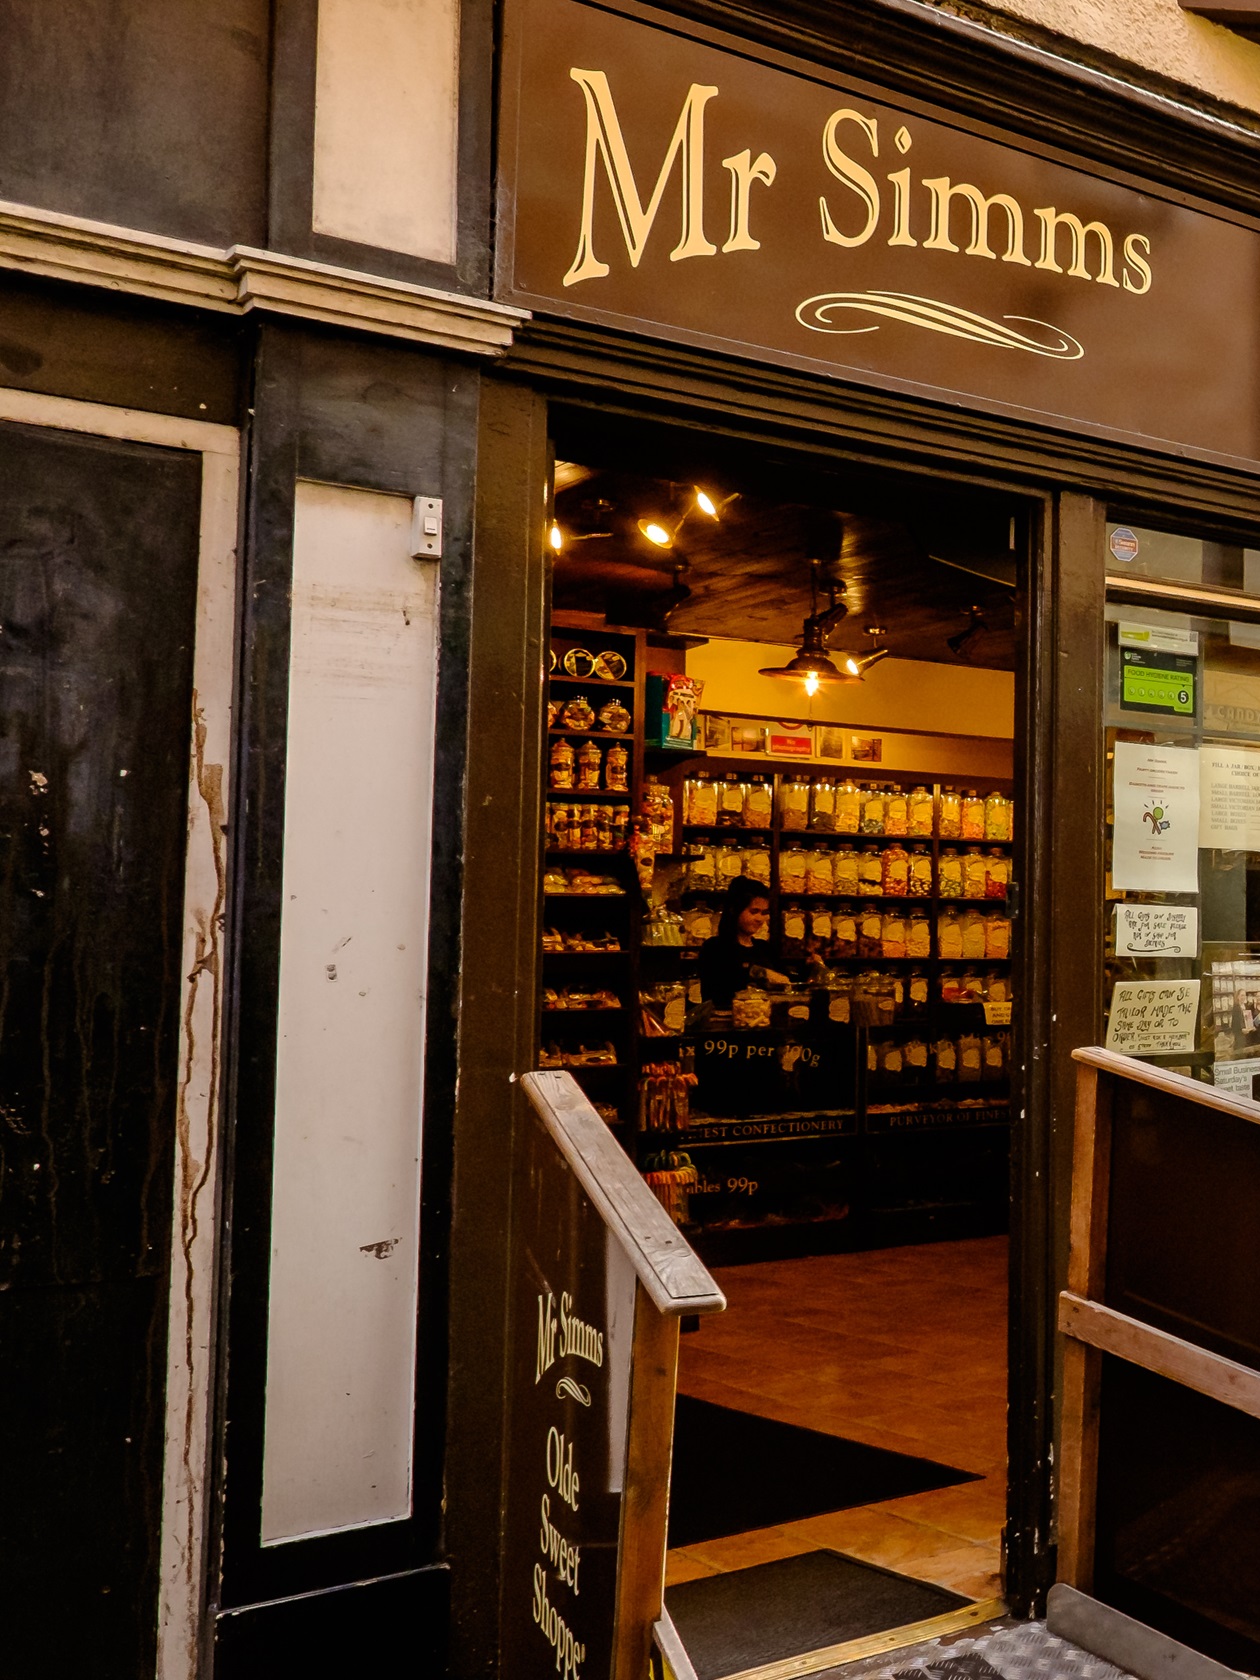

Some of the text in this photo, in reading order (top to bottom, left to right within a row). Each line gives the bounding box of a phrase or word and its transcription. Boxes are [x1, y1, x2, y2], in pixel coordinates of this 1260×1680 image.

[563, 67, 777, 287] Mr
[819, 108, 1153, 295] Simms
[1180, 692, 1187, 702] 5
[1124, 910, 1134, 920] ALL
[1119, 987, 1190, 1003] ALL GIFTS CAN BE
[1117, 1003, 1193, 1019] TAILOR MADE THE
[1114, 1018, 1179, 1032] SAME DAY OR TO
[678, 1042, 695, 1058] ix
[704, 1040, 739, 1059] 99p
[746, 1045, 775, 1059] per
[1215, 1066, 1260, 1076] Small Business
[1215, 1075, 1247, 1085] Saturday's
[732, 1118, 844, 1136] CONFECTIONERY
[889, 1109, 1010, 1127] PURVEYOR OF FINES
[727, 1176, 759, 1196] 99p
[536, 1291, 603, 1384] Mr Simms
[547, 1426, 579, 1512] Olde
[540, 1494, 580, 1596] Sweet
